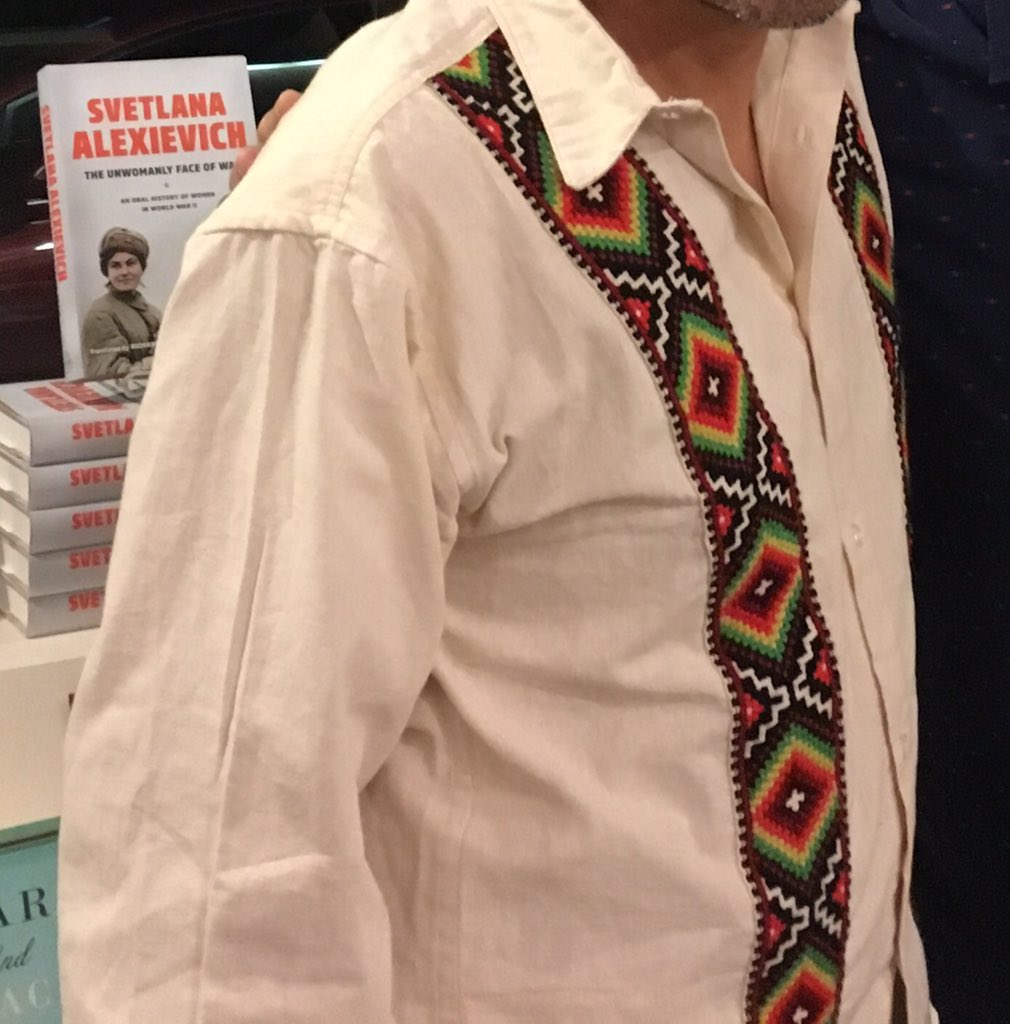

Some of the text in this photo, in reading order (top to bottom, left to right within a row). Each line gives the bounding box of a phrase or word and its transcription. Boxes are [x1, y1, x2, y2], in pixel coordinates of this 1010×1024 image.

[86, 91, 226, 124] SVETLANA
[72, 120, 247, 160] ALEXIEVICH
[84, 160, 235, 180] THE UNWOMANLY FACE OF WA
